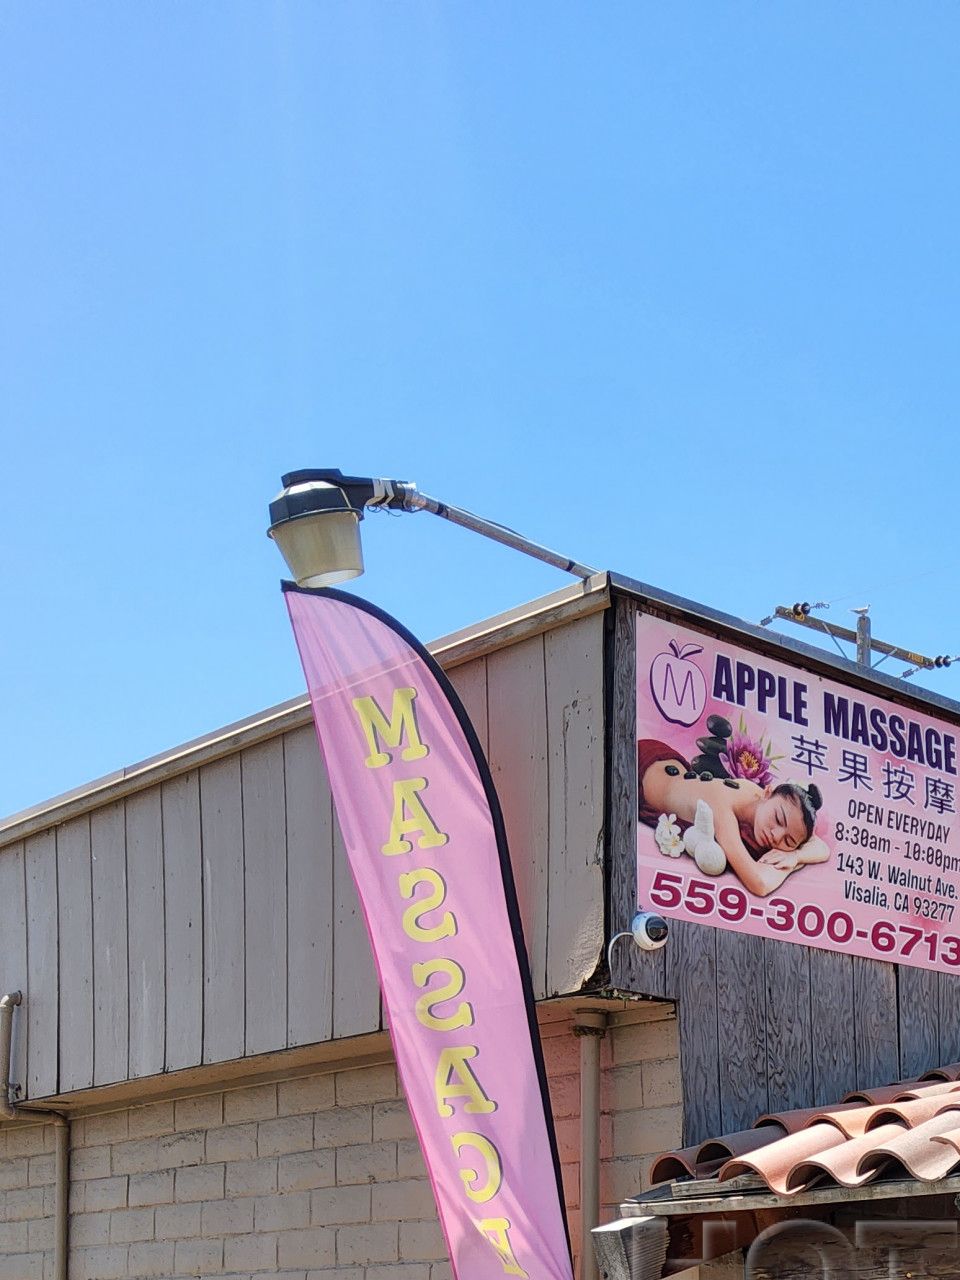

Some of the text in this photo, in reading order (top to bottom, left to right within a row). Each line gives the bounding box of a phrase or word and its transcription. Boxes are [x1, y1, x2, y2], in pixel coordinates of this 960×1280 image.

[662, 662, 697, 712] M
[712, 654, 958, 776] APPLE MASSAGE
[790, 734, 957, 816] 苹果按摩
[835, 821, 891, 854] 8:30am
[847, 798, 951, 844] OPEN EVERYDAY
[836, 852, 959, 901] 143 W. Walnut Ave.
[844, 879, 955, 923] Visalia, CA 93277
